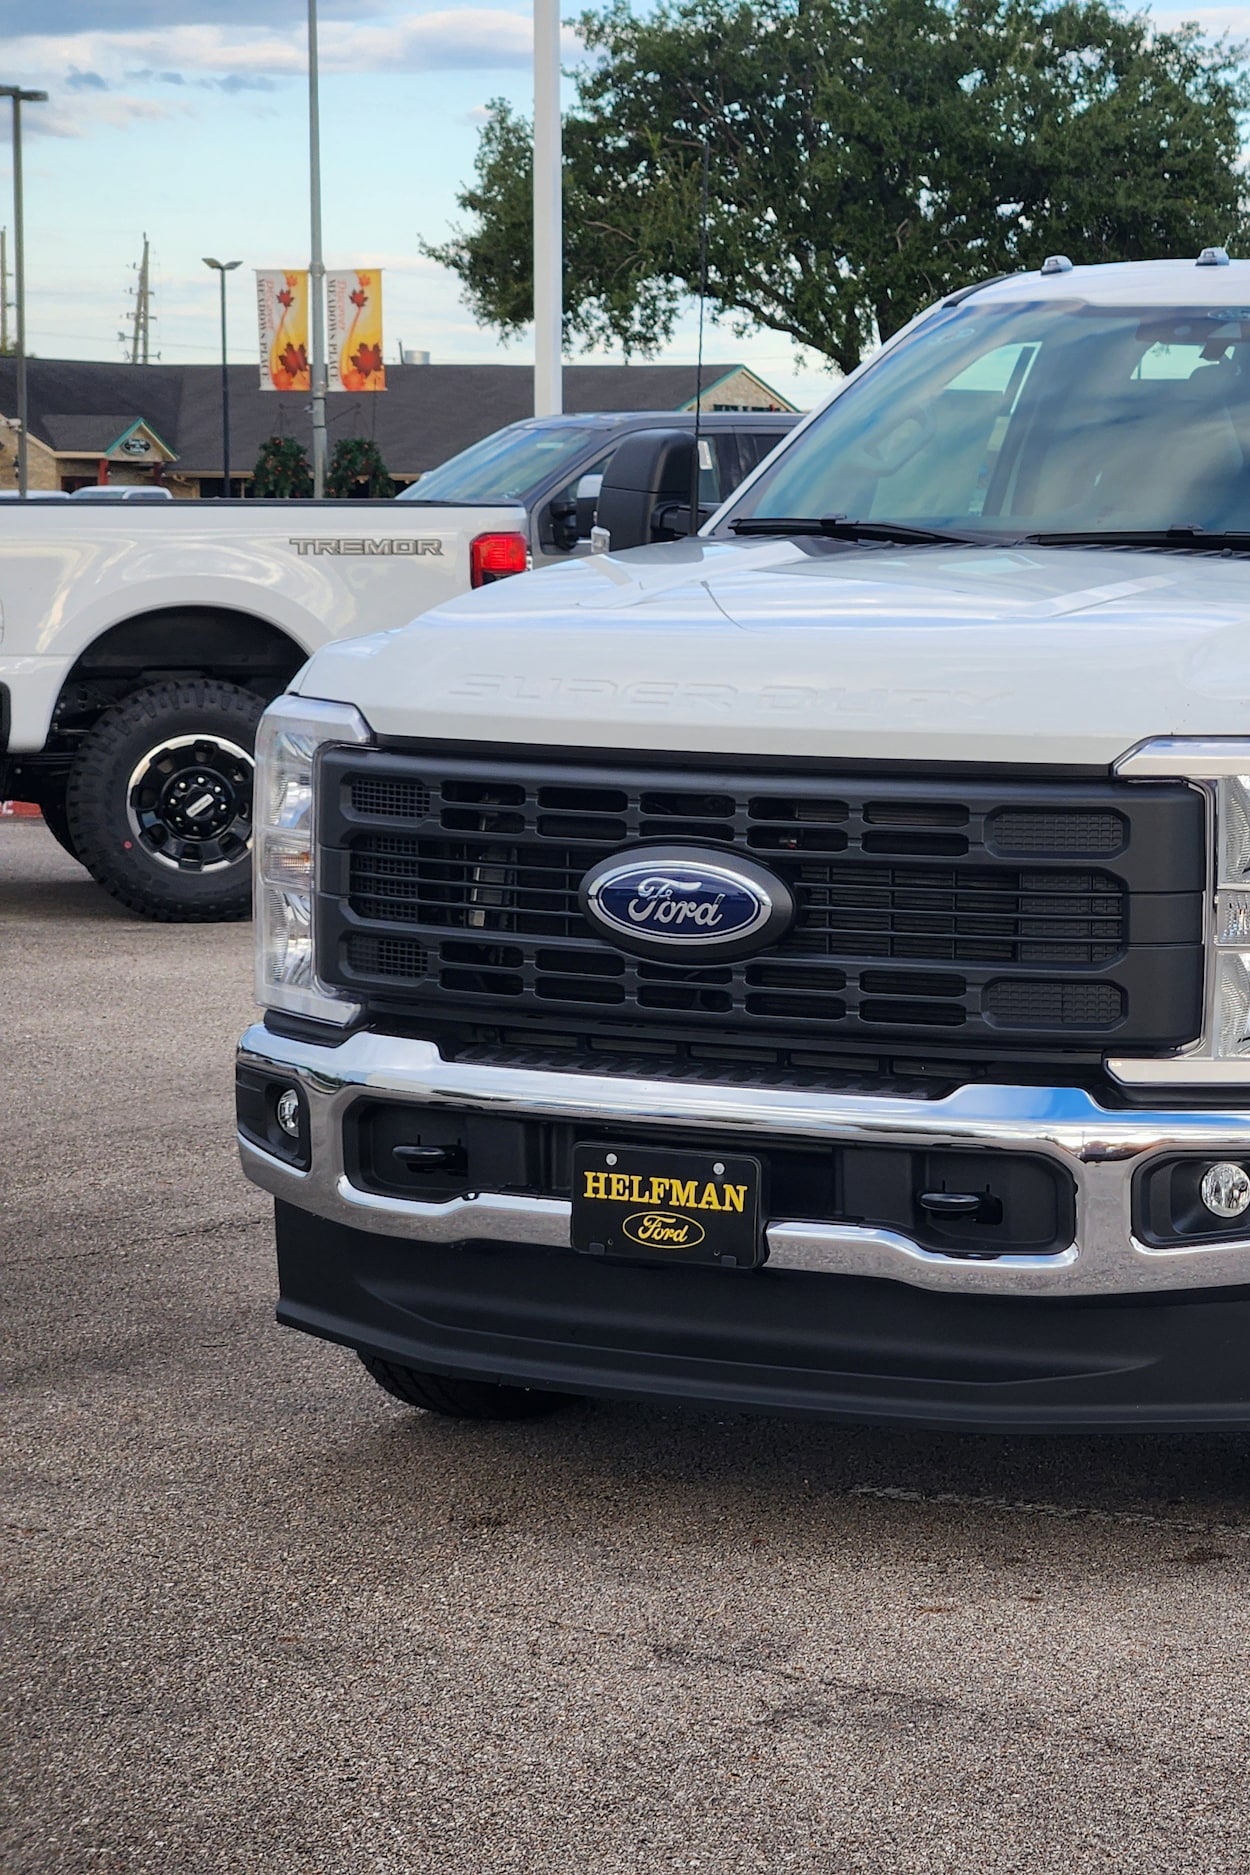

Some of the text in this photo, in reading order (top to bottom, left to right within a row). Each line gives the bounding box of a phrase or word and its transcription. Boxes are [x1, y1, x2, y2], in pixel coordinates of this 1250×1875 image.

[257, 278, 270, 380] MEADOWS PLACE
[327, 278, 339, 380] MEADOWS PLACE
[289, 538, 444, 556] TREMOR
[448, 674, 1015, 718] SUPER DUTY
[628, 876, 726, 927] Ford
[583, 1171, 748, 1213] HELFMAN
[637, 1214, 689, 1243] Ford
